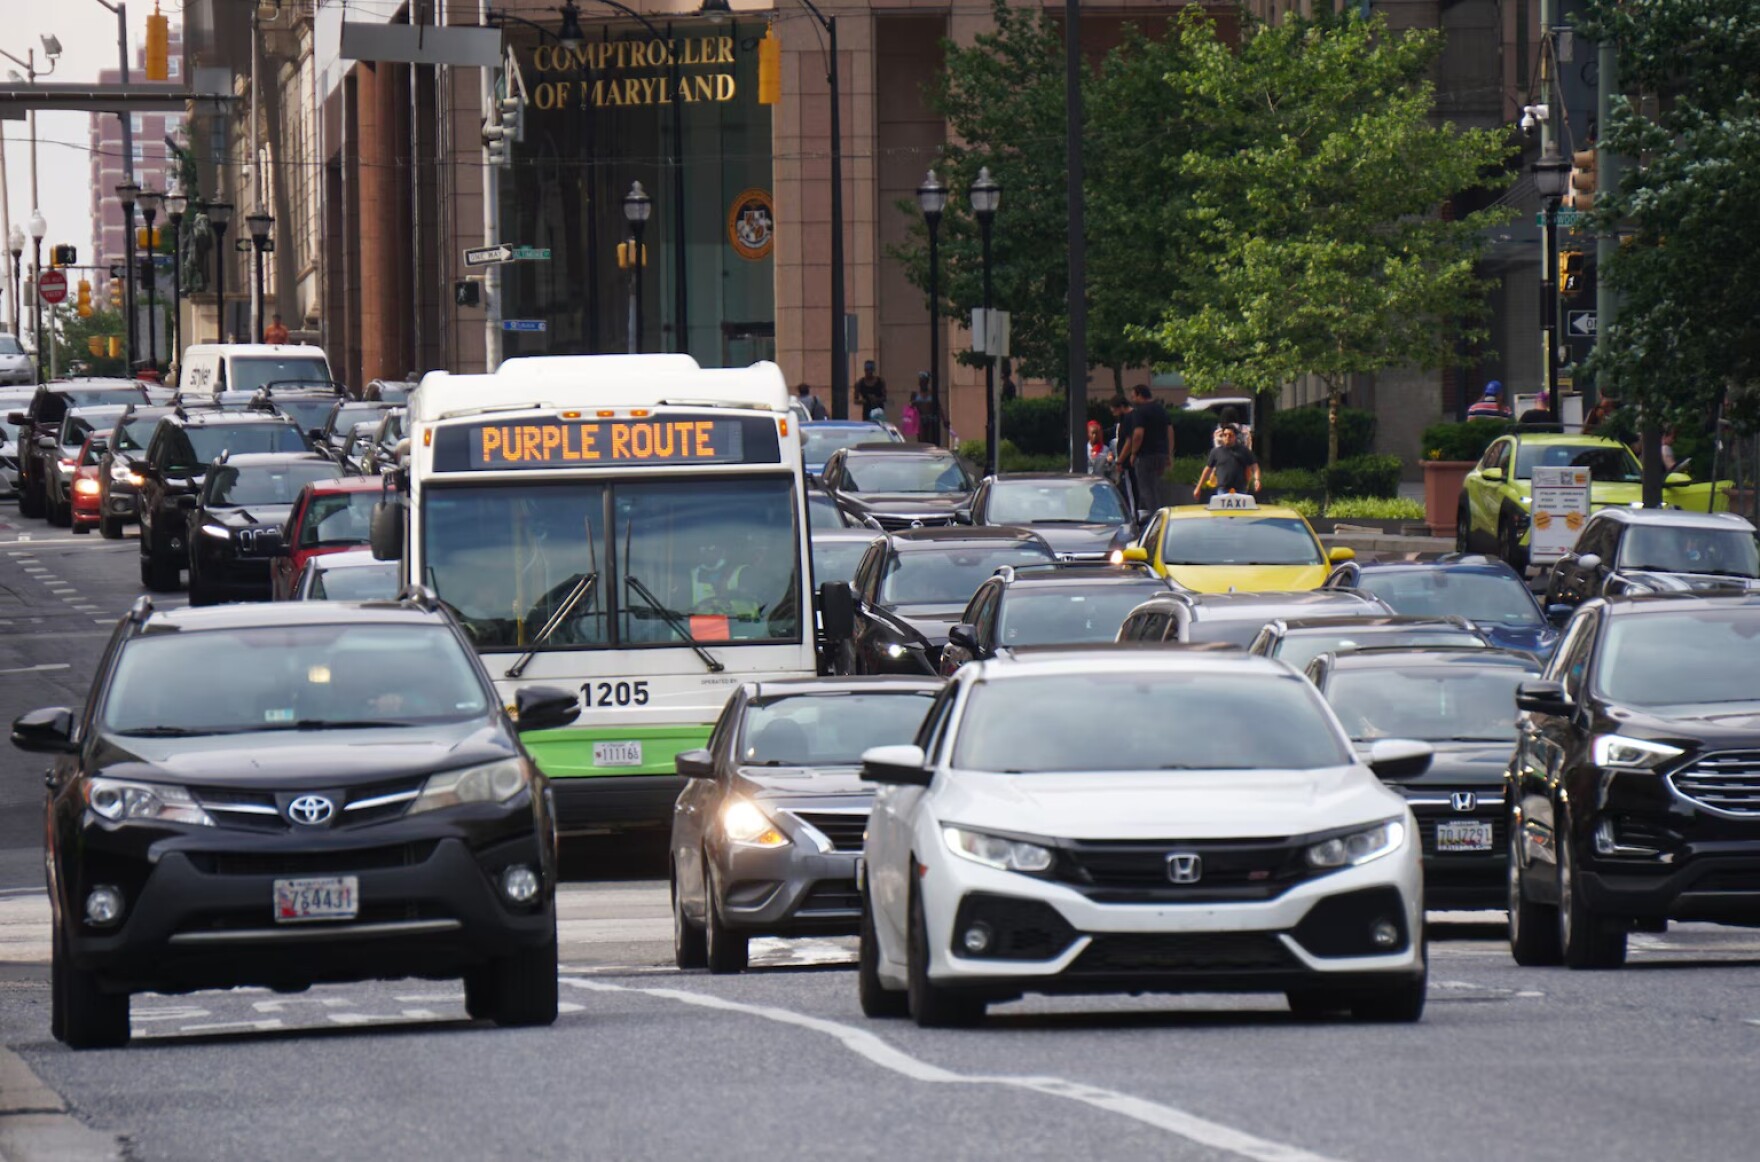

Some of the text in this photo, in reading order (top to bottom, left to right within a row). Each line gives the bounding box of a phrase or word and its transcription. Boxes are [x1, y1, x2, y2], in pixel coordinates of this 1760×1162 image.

[533, 36, 735, 71] COMPTROLLER
[534, 73, 736, 110] OF MARYLAND
[482, 421, 715, 461] PURPLE ROUTE
[1220, 499, 1247, 508] TAXI
[580, 681, 649, 707] 1205
